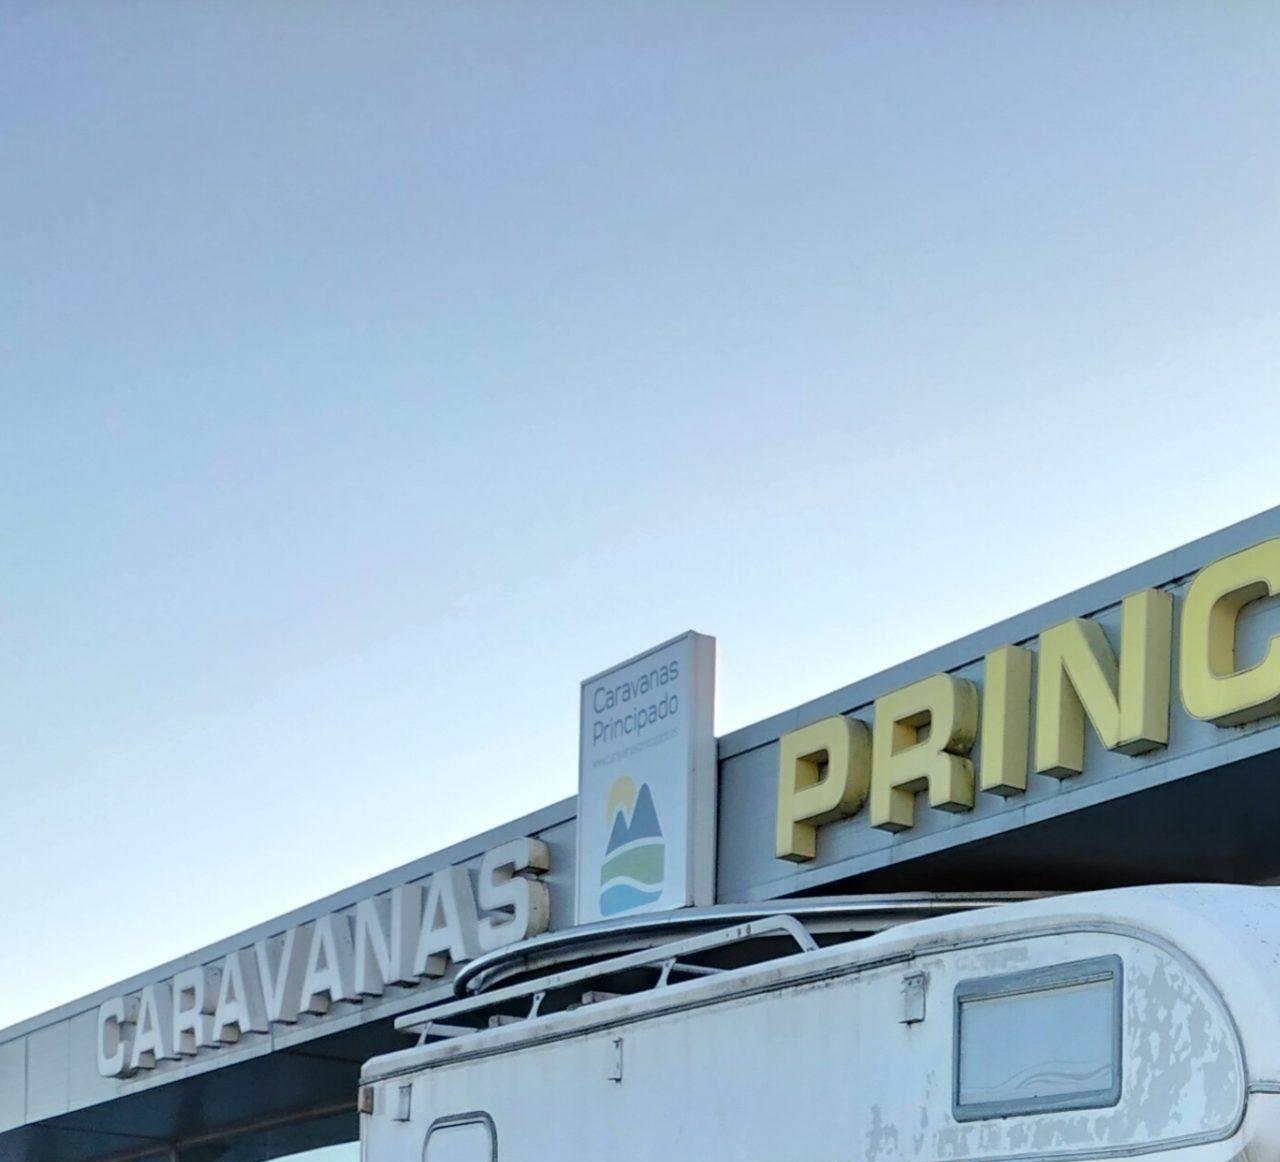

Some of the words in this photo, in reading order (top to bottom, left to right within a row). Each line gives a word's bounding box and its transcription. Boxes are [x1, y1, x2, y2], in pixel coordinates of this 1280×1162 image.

[593, 660, 679, 714] Caravanas
[592, 691, 679, 746] Principado
[98, 836, 549, 1078] CARAVANAS
